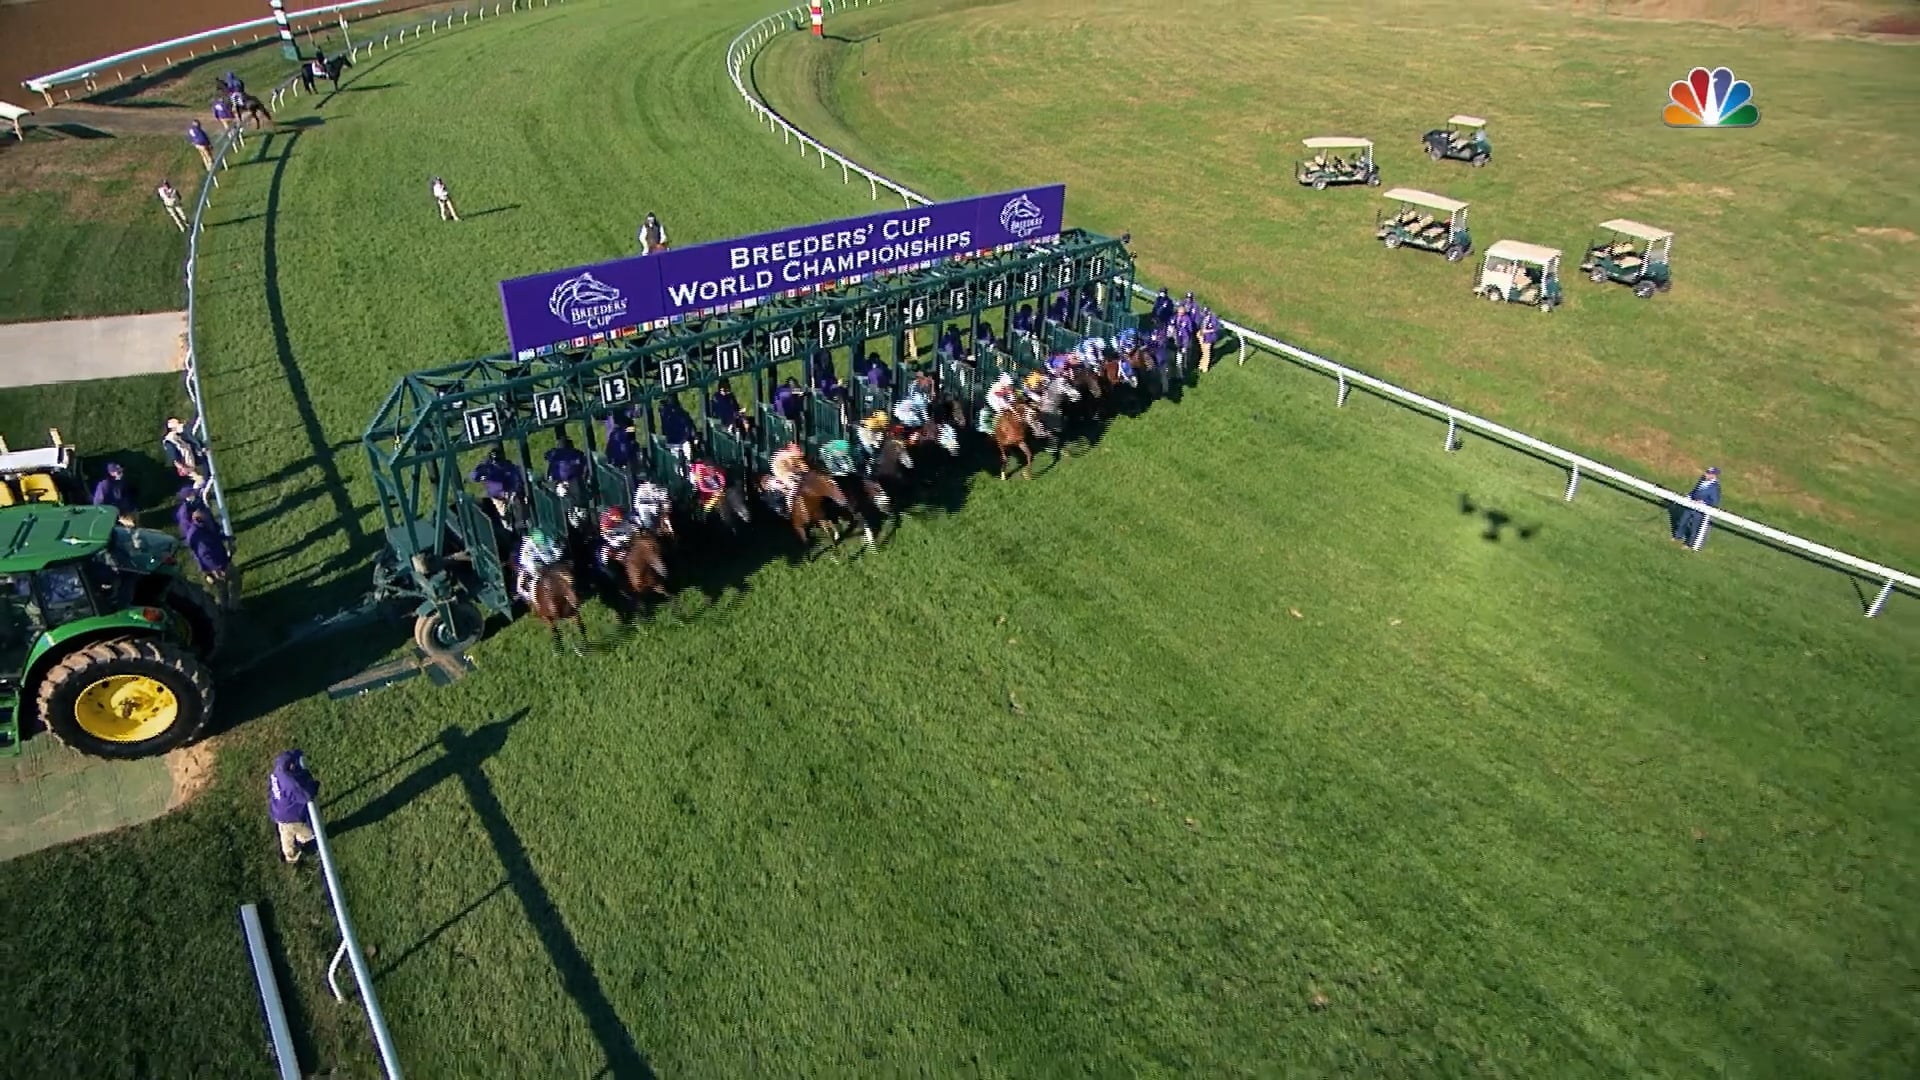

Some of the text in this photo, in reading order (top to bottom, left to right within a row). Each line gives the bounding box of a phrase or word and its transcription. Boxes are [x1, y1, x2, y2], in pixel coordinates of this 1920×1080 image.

[883, 216, 931, 240] CUP
[668, 231, 971, 306] WORLD CHAMPIONSHIPS
[1063, 267, 1071, 284] 2
[993, 283, 1002, 300] 4
[1029, 274, 1038, 292] 3
[915, 302, 924, 320] 6
[956, 292, 964, 310] 5
[587, 314, 611, 329] CUP
[872, 311, 882, 330] 7
[826, 323, 836, 341] 9
[773, 335, 791, 356] 10
[723, 346, 740, 370] 11
[665, 363, 685, 385] 12
[604, 378, 626, 401] 13
[538, 395, 563, 419] 14
[470, 412, 496, 437] 15
